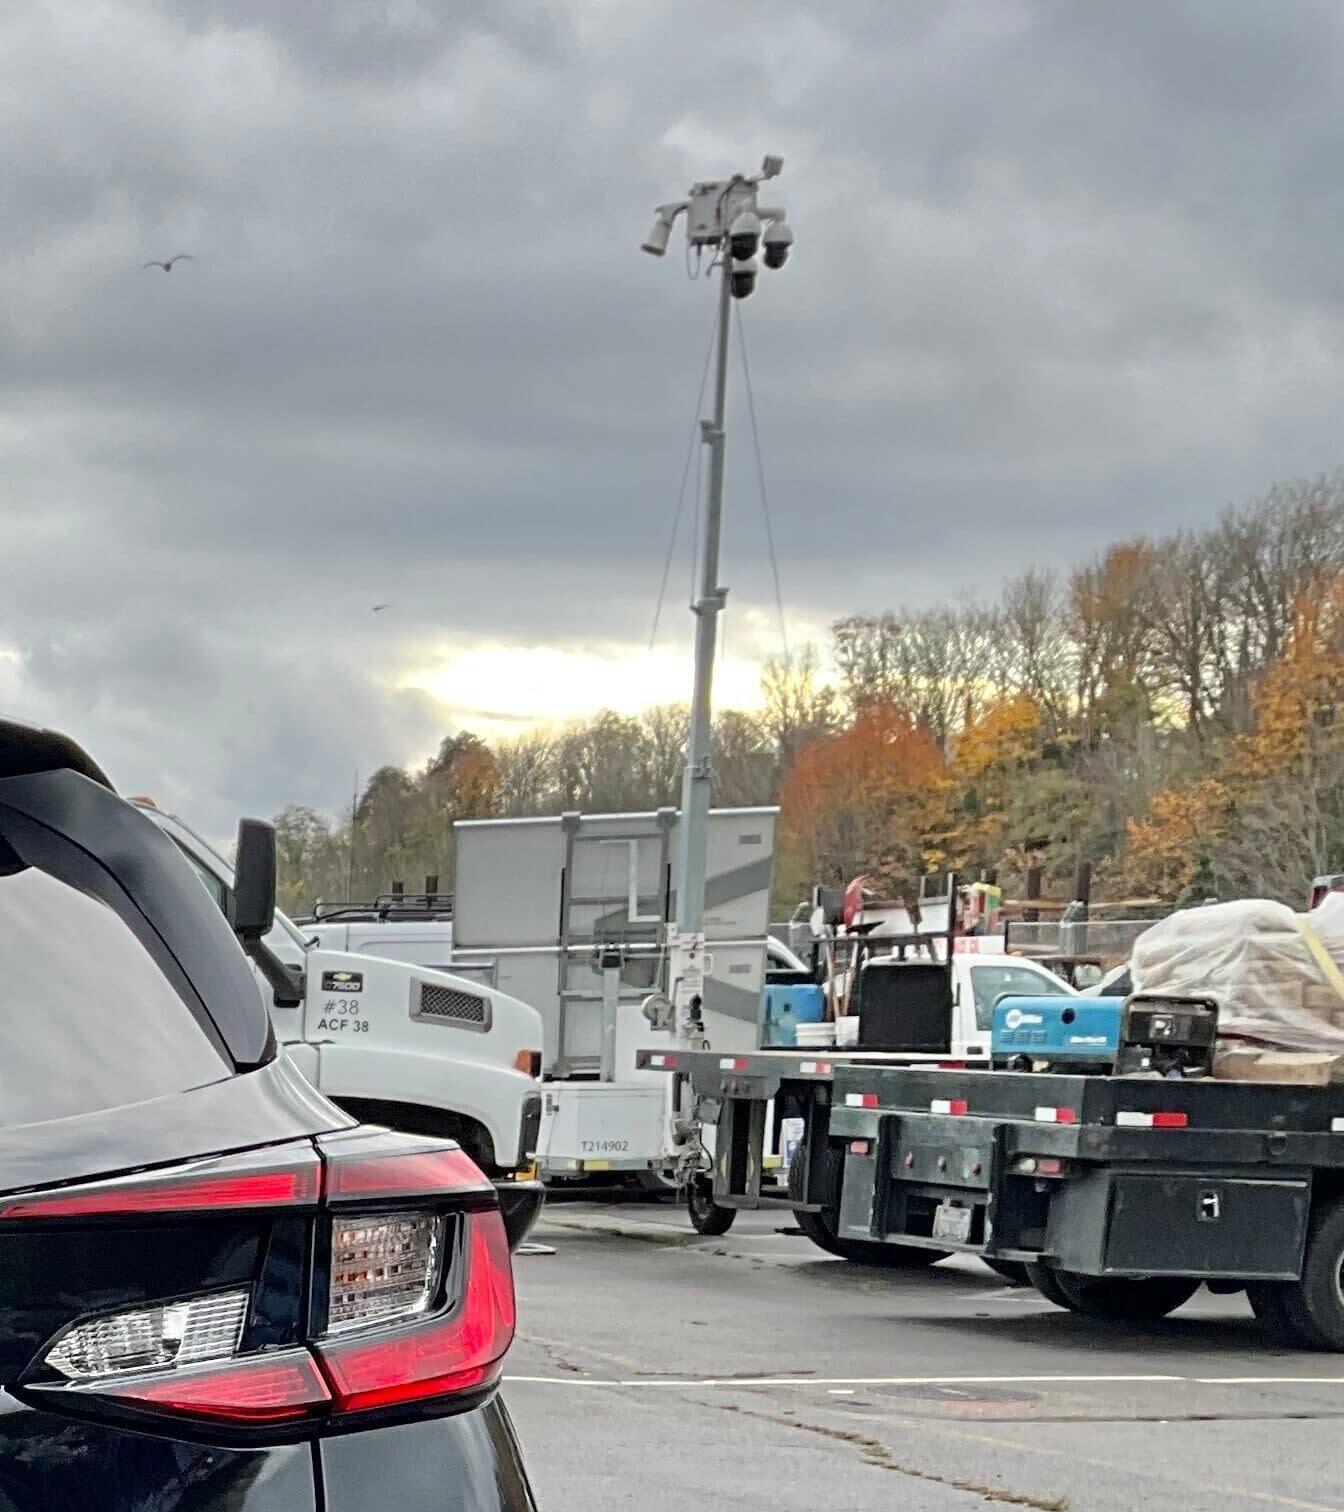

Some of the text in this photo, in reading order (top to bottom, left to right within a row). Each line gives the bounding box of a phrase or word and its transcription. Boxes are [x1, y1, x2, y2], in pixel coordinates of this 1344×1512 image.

[323, 999, 359, 1014] #38
[317, 1018, 369, 1032] ACF 38
[581, 1140, 629, 1152] T214902
